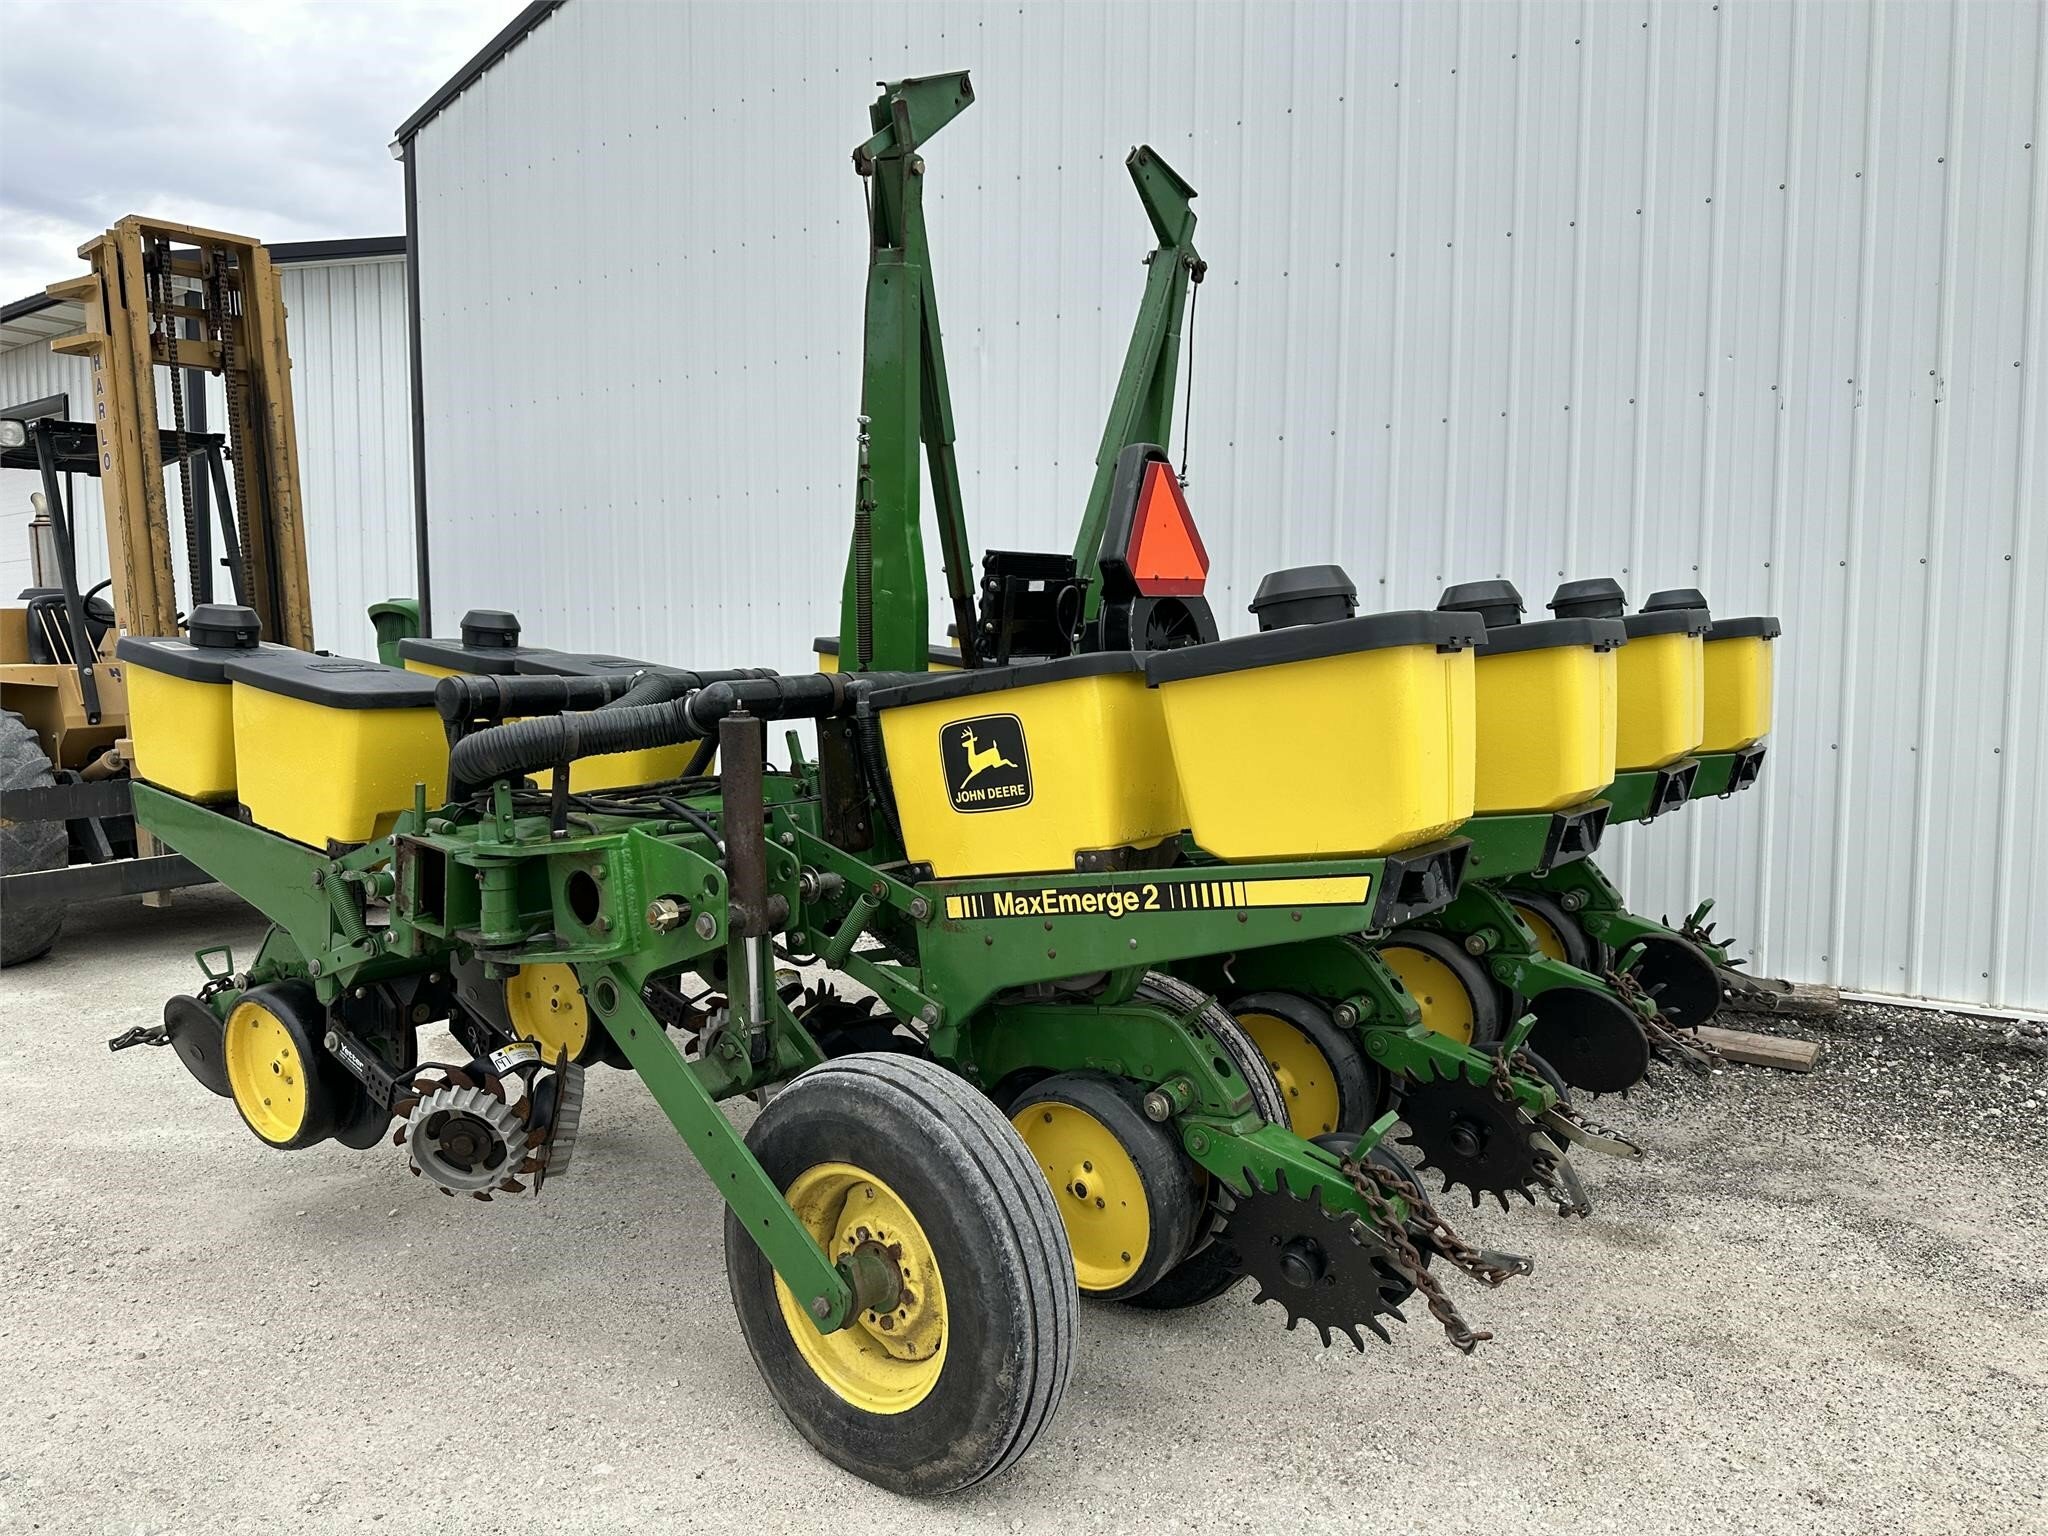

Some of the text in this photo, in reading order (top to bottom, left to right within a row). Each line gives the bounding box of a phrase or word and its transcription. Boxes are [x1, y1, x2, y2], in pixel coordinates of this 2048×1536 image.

[93, 352, 111, 471] HARLO
[955, 784, 1026, 803] JOHN DEERE
[993, 883, 1161, 917] MaxEmerge 2
[340, 1041, 364, 1068] Yetter
